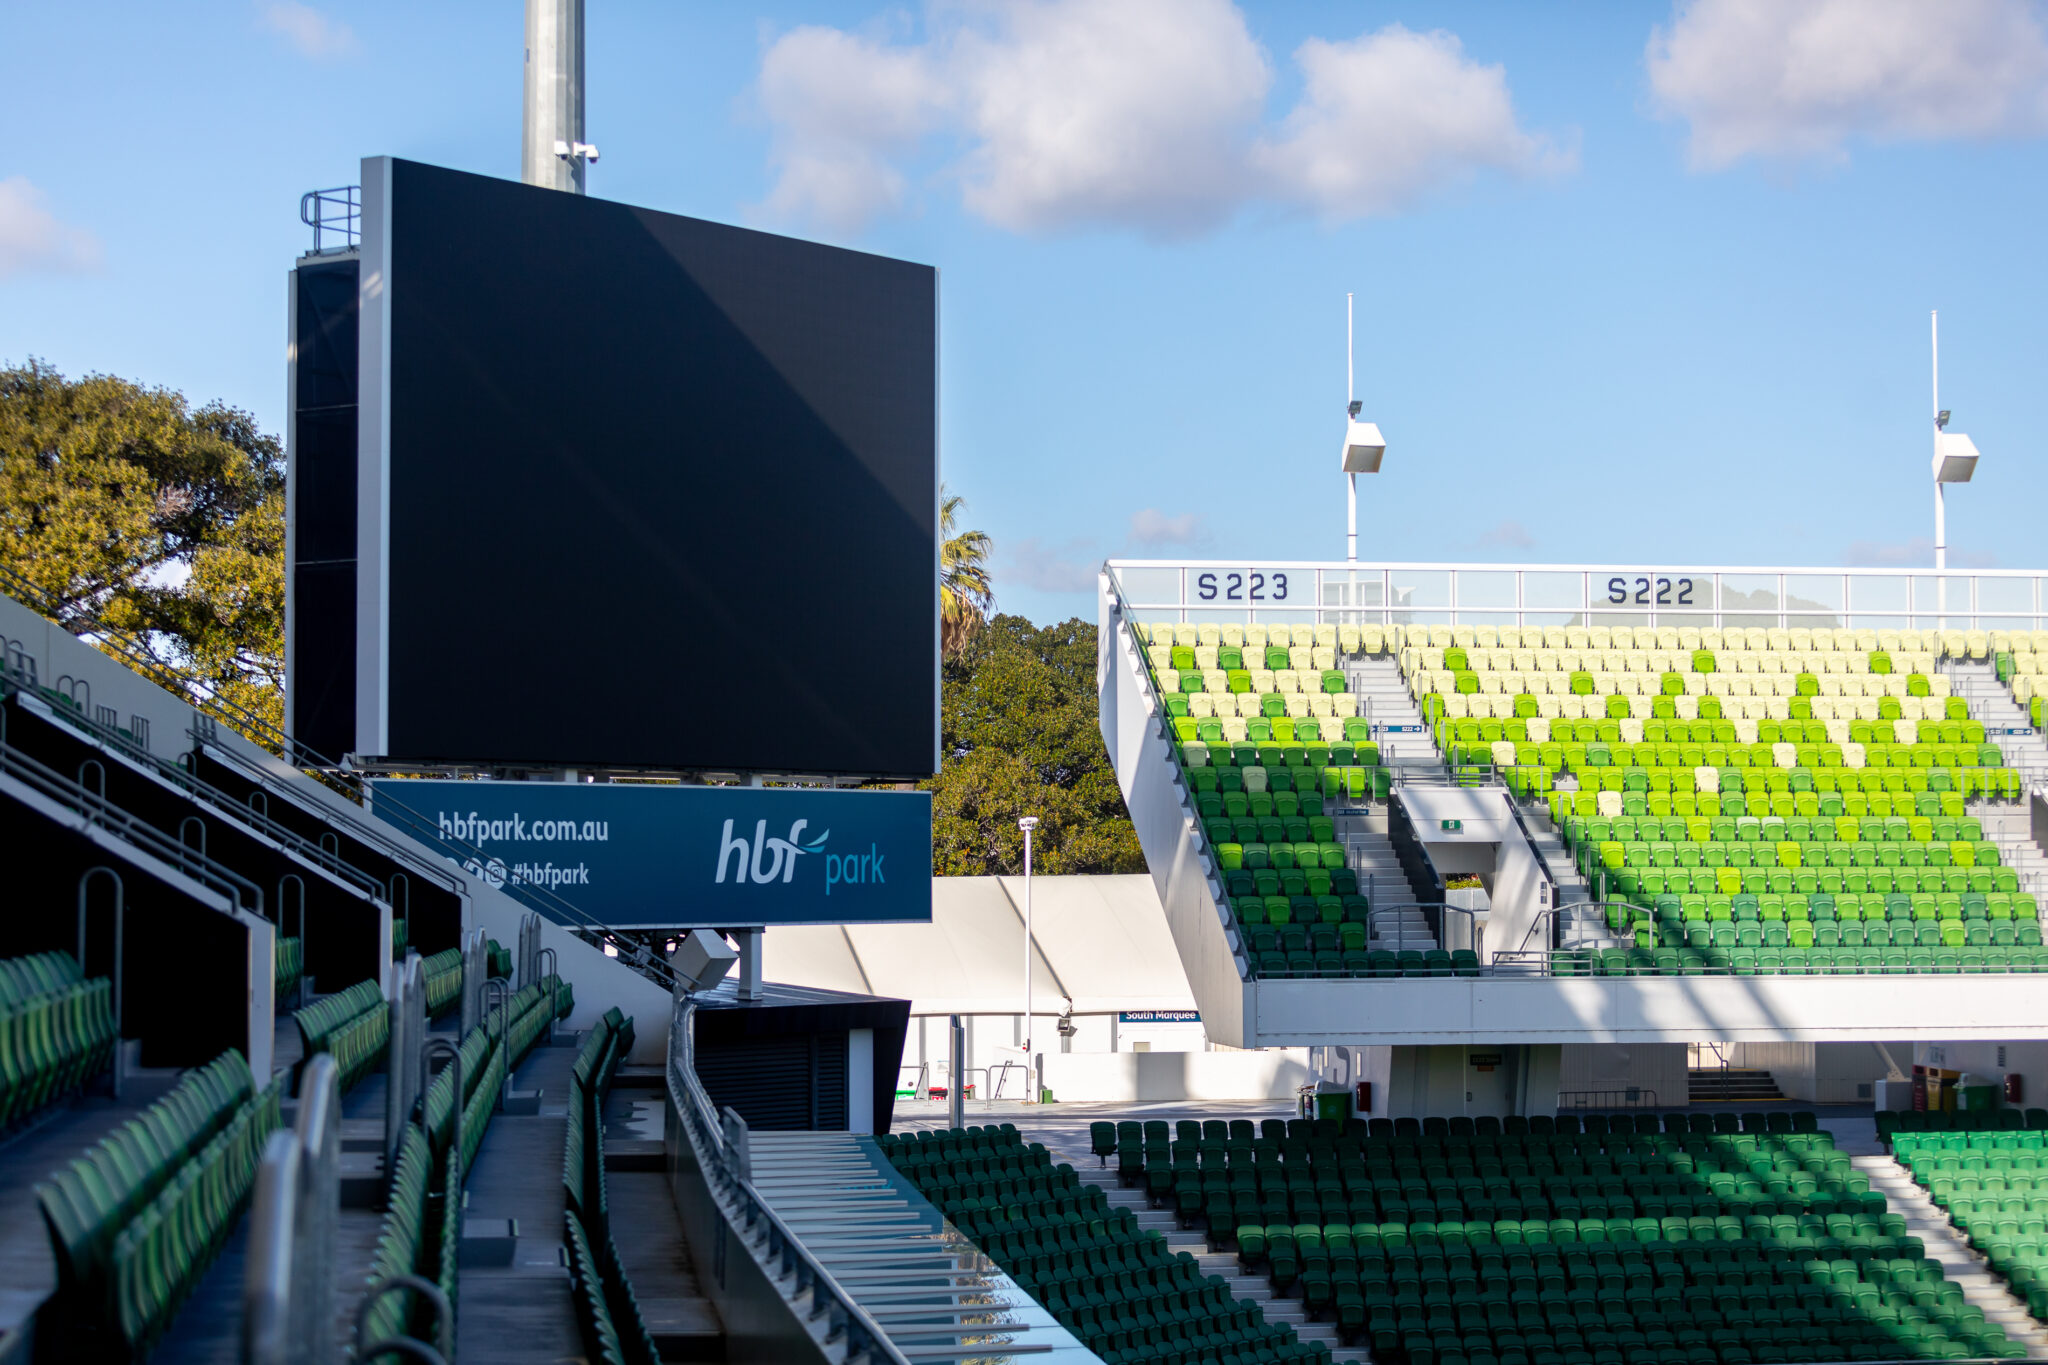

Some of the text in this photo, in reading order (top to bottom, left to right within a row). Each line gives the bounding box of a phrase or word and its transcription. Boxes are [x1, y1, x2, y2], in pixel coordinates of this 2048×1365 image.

[1198, 573, 1287, 600] S223
[1608, 578, 1693, 604] S222
[439, 811, 608, 848] hbfpark.com.au
[715, 819, 885, 896] hbf park
[512, 862, 589, 890] #hbfpark
[1126, 1011, 1196, 1021] South Marquee
